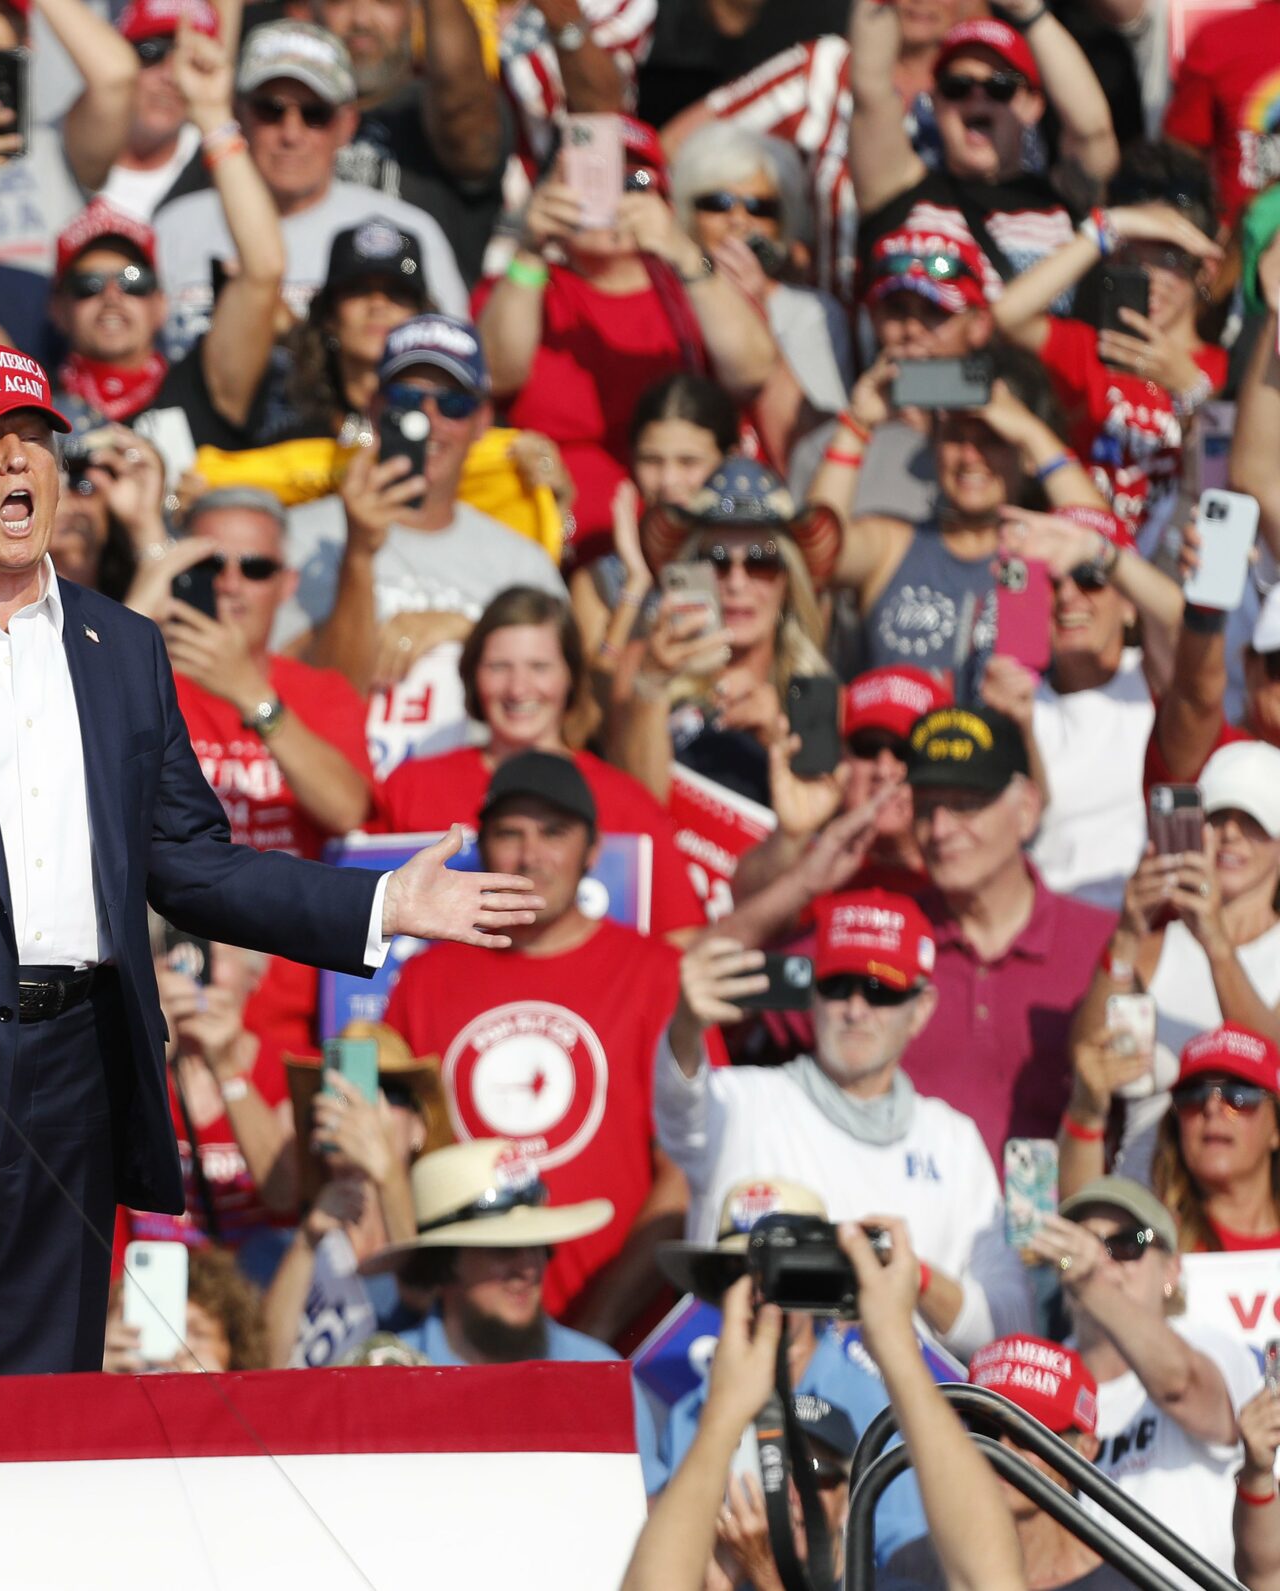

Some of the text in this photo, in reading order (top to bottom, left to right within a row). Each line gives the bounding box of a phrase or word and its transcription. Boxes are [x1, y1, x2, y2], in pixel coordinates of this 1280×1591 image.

[5, 375, 43, 401] AGAIN
[1228, 1292, 1280, 1331] V
[1005, 1339, 1072, 1379] AMERICA
[1010, 1364, 1062, 1398] AGAIN
